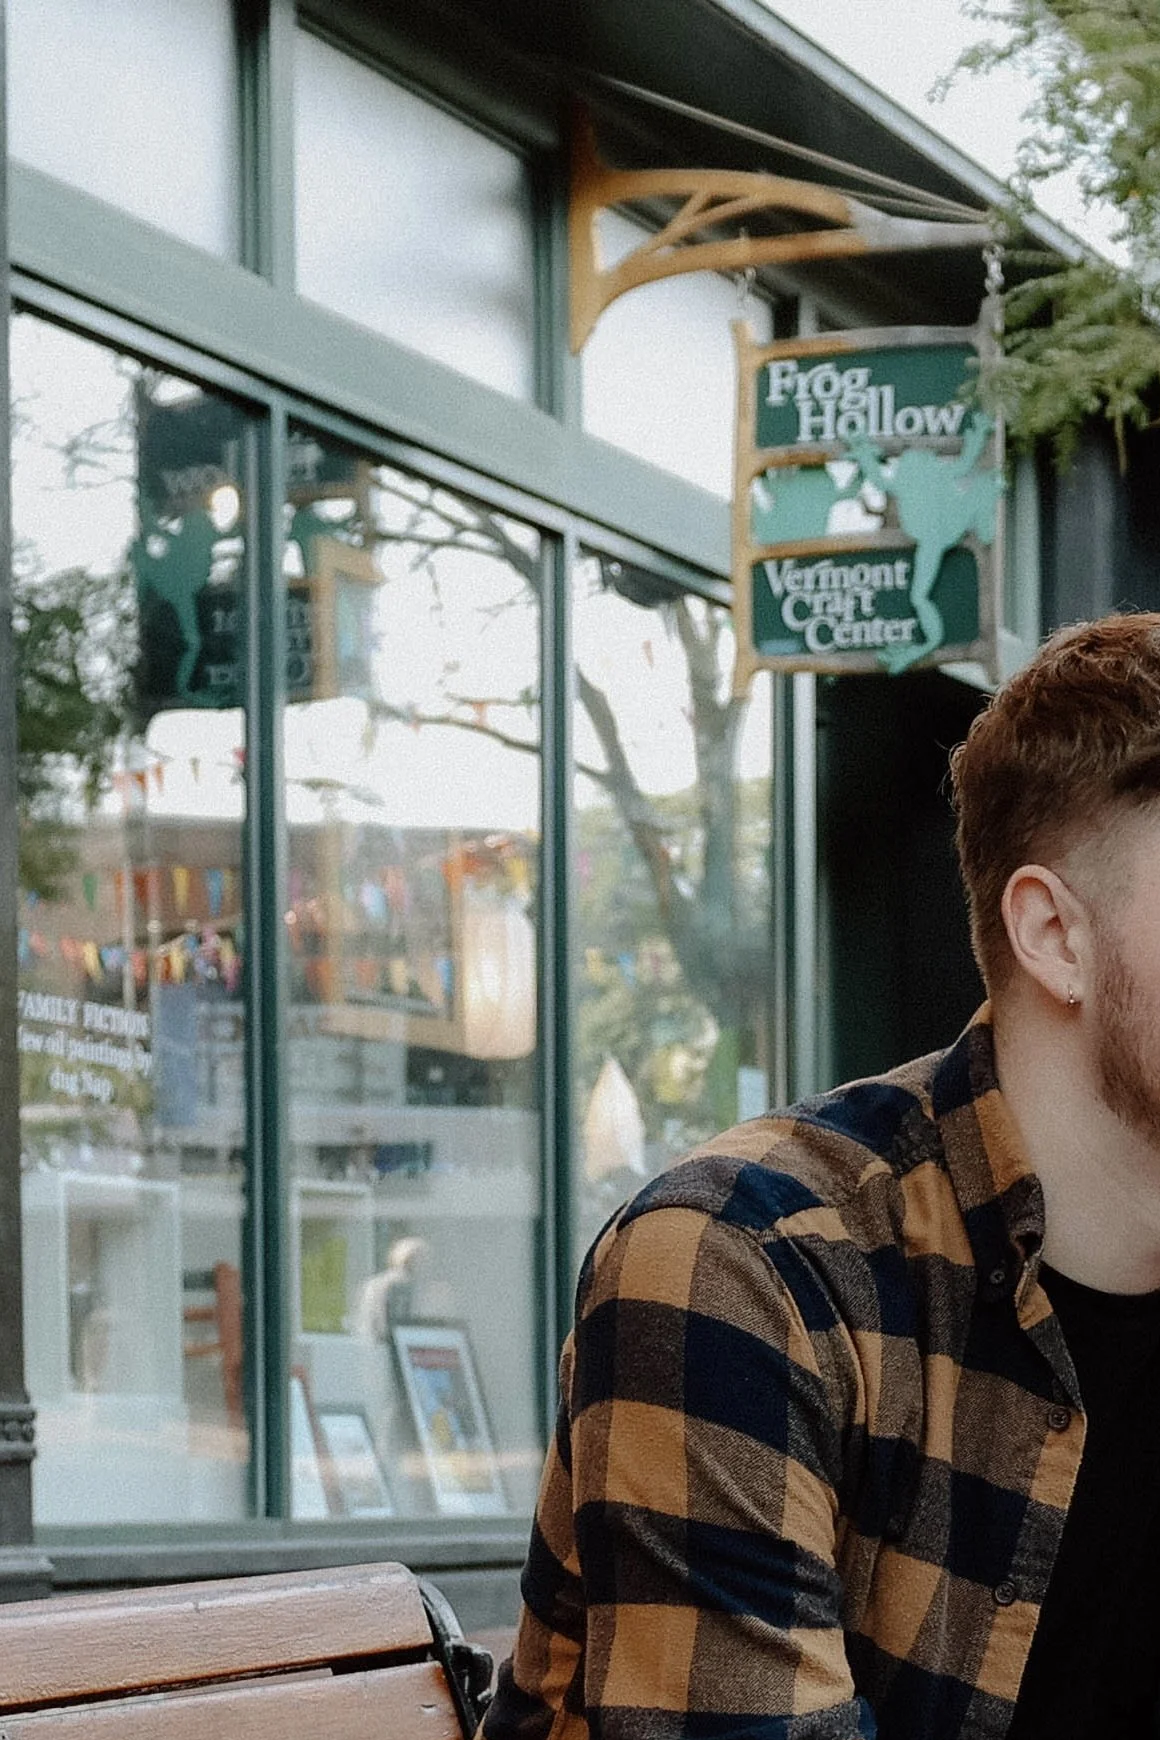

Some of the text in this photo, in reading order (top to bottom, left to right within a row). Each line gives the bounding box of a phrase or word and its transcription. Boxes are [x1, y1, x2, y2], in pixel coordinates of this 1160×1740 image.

[765, 359, 872, 412] Frog
[796, 383, 966, 441] Hollow
[763, 558, 910, 599] Vermont
[781, 588, 876, 631] Craft
[804, 616, 916, 655] Center
